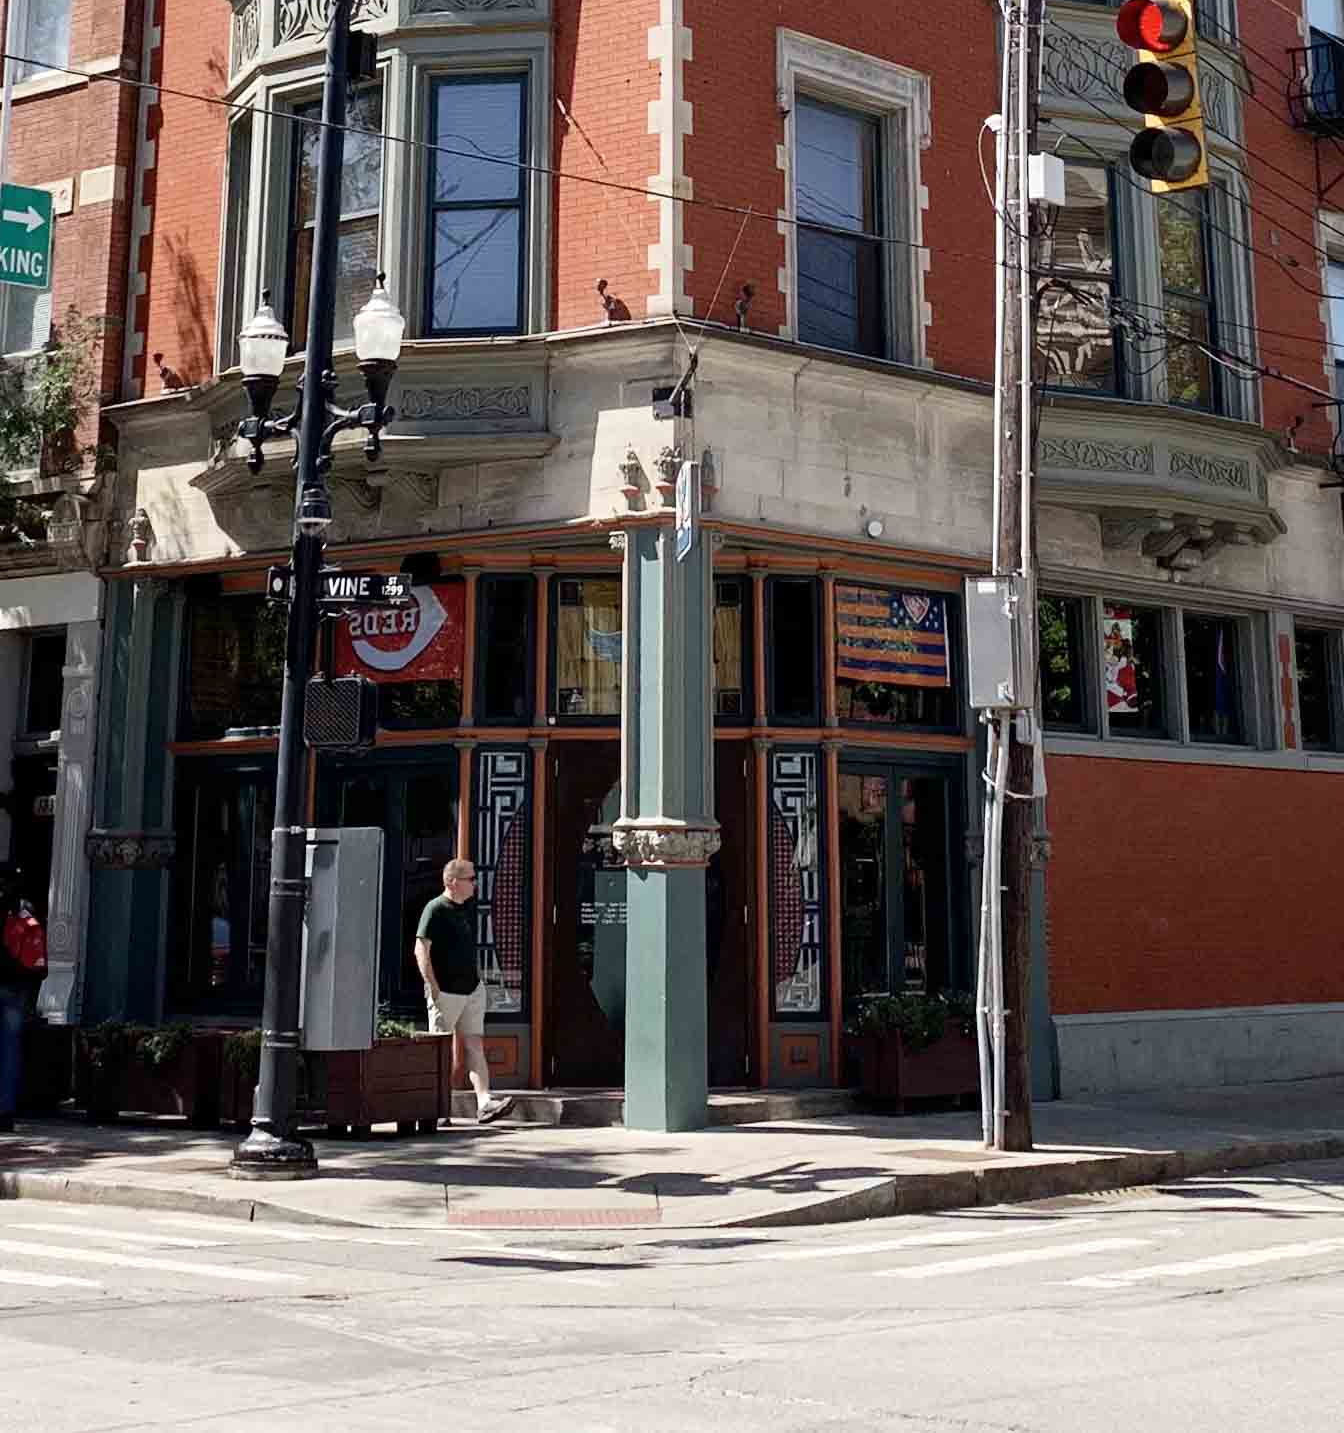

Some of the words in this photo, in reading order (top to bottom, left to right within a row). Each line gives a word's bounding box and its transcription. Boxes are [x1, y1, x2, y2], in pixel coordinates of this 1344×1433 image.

[327, 576, 372, 597] VINE
[387, 576, 399, 586] ST
[381, 584, 405, 597] 1299
